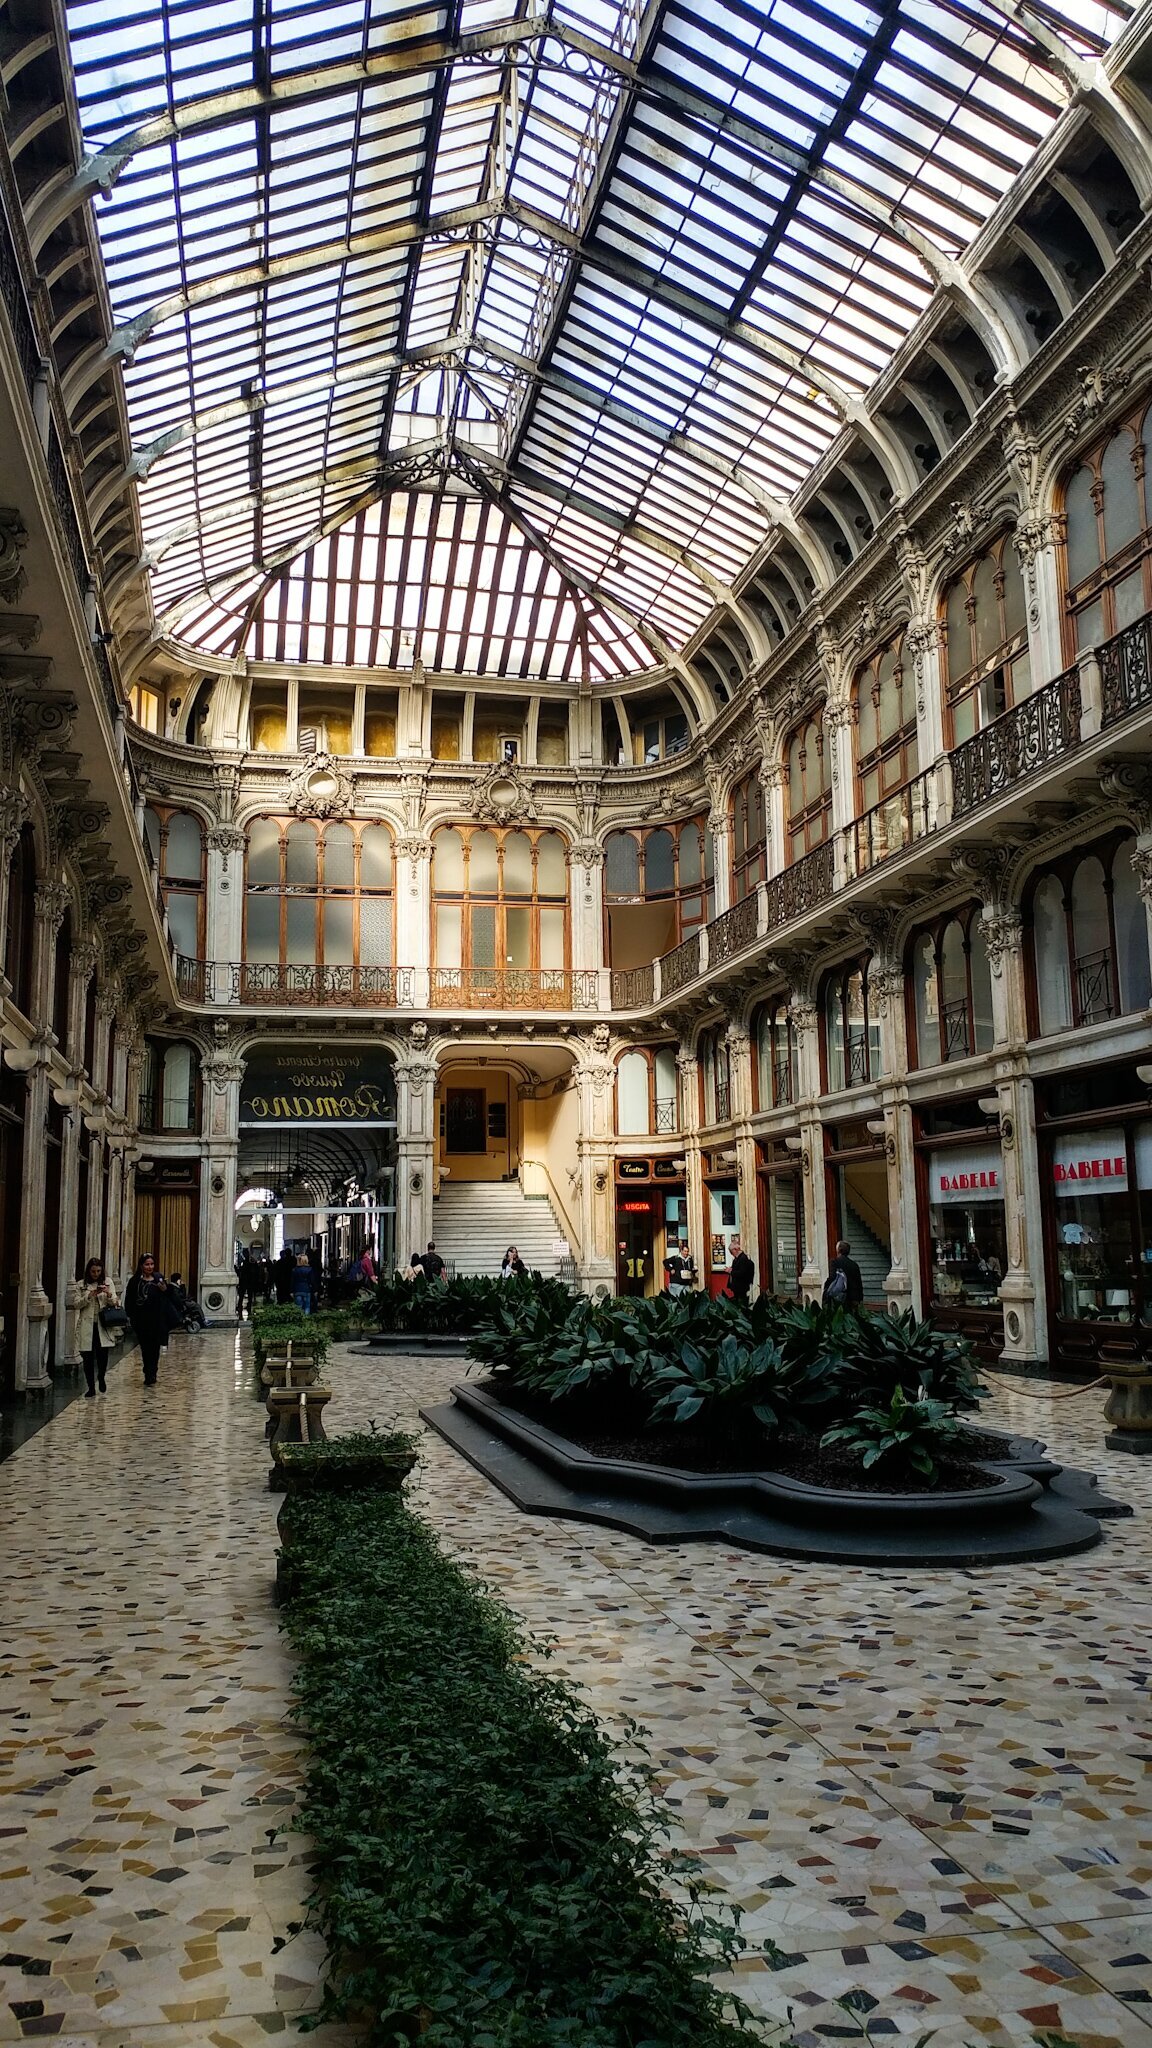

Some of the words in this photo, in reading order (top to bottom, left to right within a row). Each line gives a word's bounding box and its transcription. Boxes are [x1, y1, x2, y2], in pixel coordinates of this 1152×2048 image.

[622, 1164, 644, 1173] Teatro
[1054, 1157, 1126, 1181] BABELE
[940, 1171, 998, 1191] BABELE
